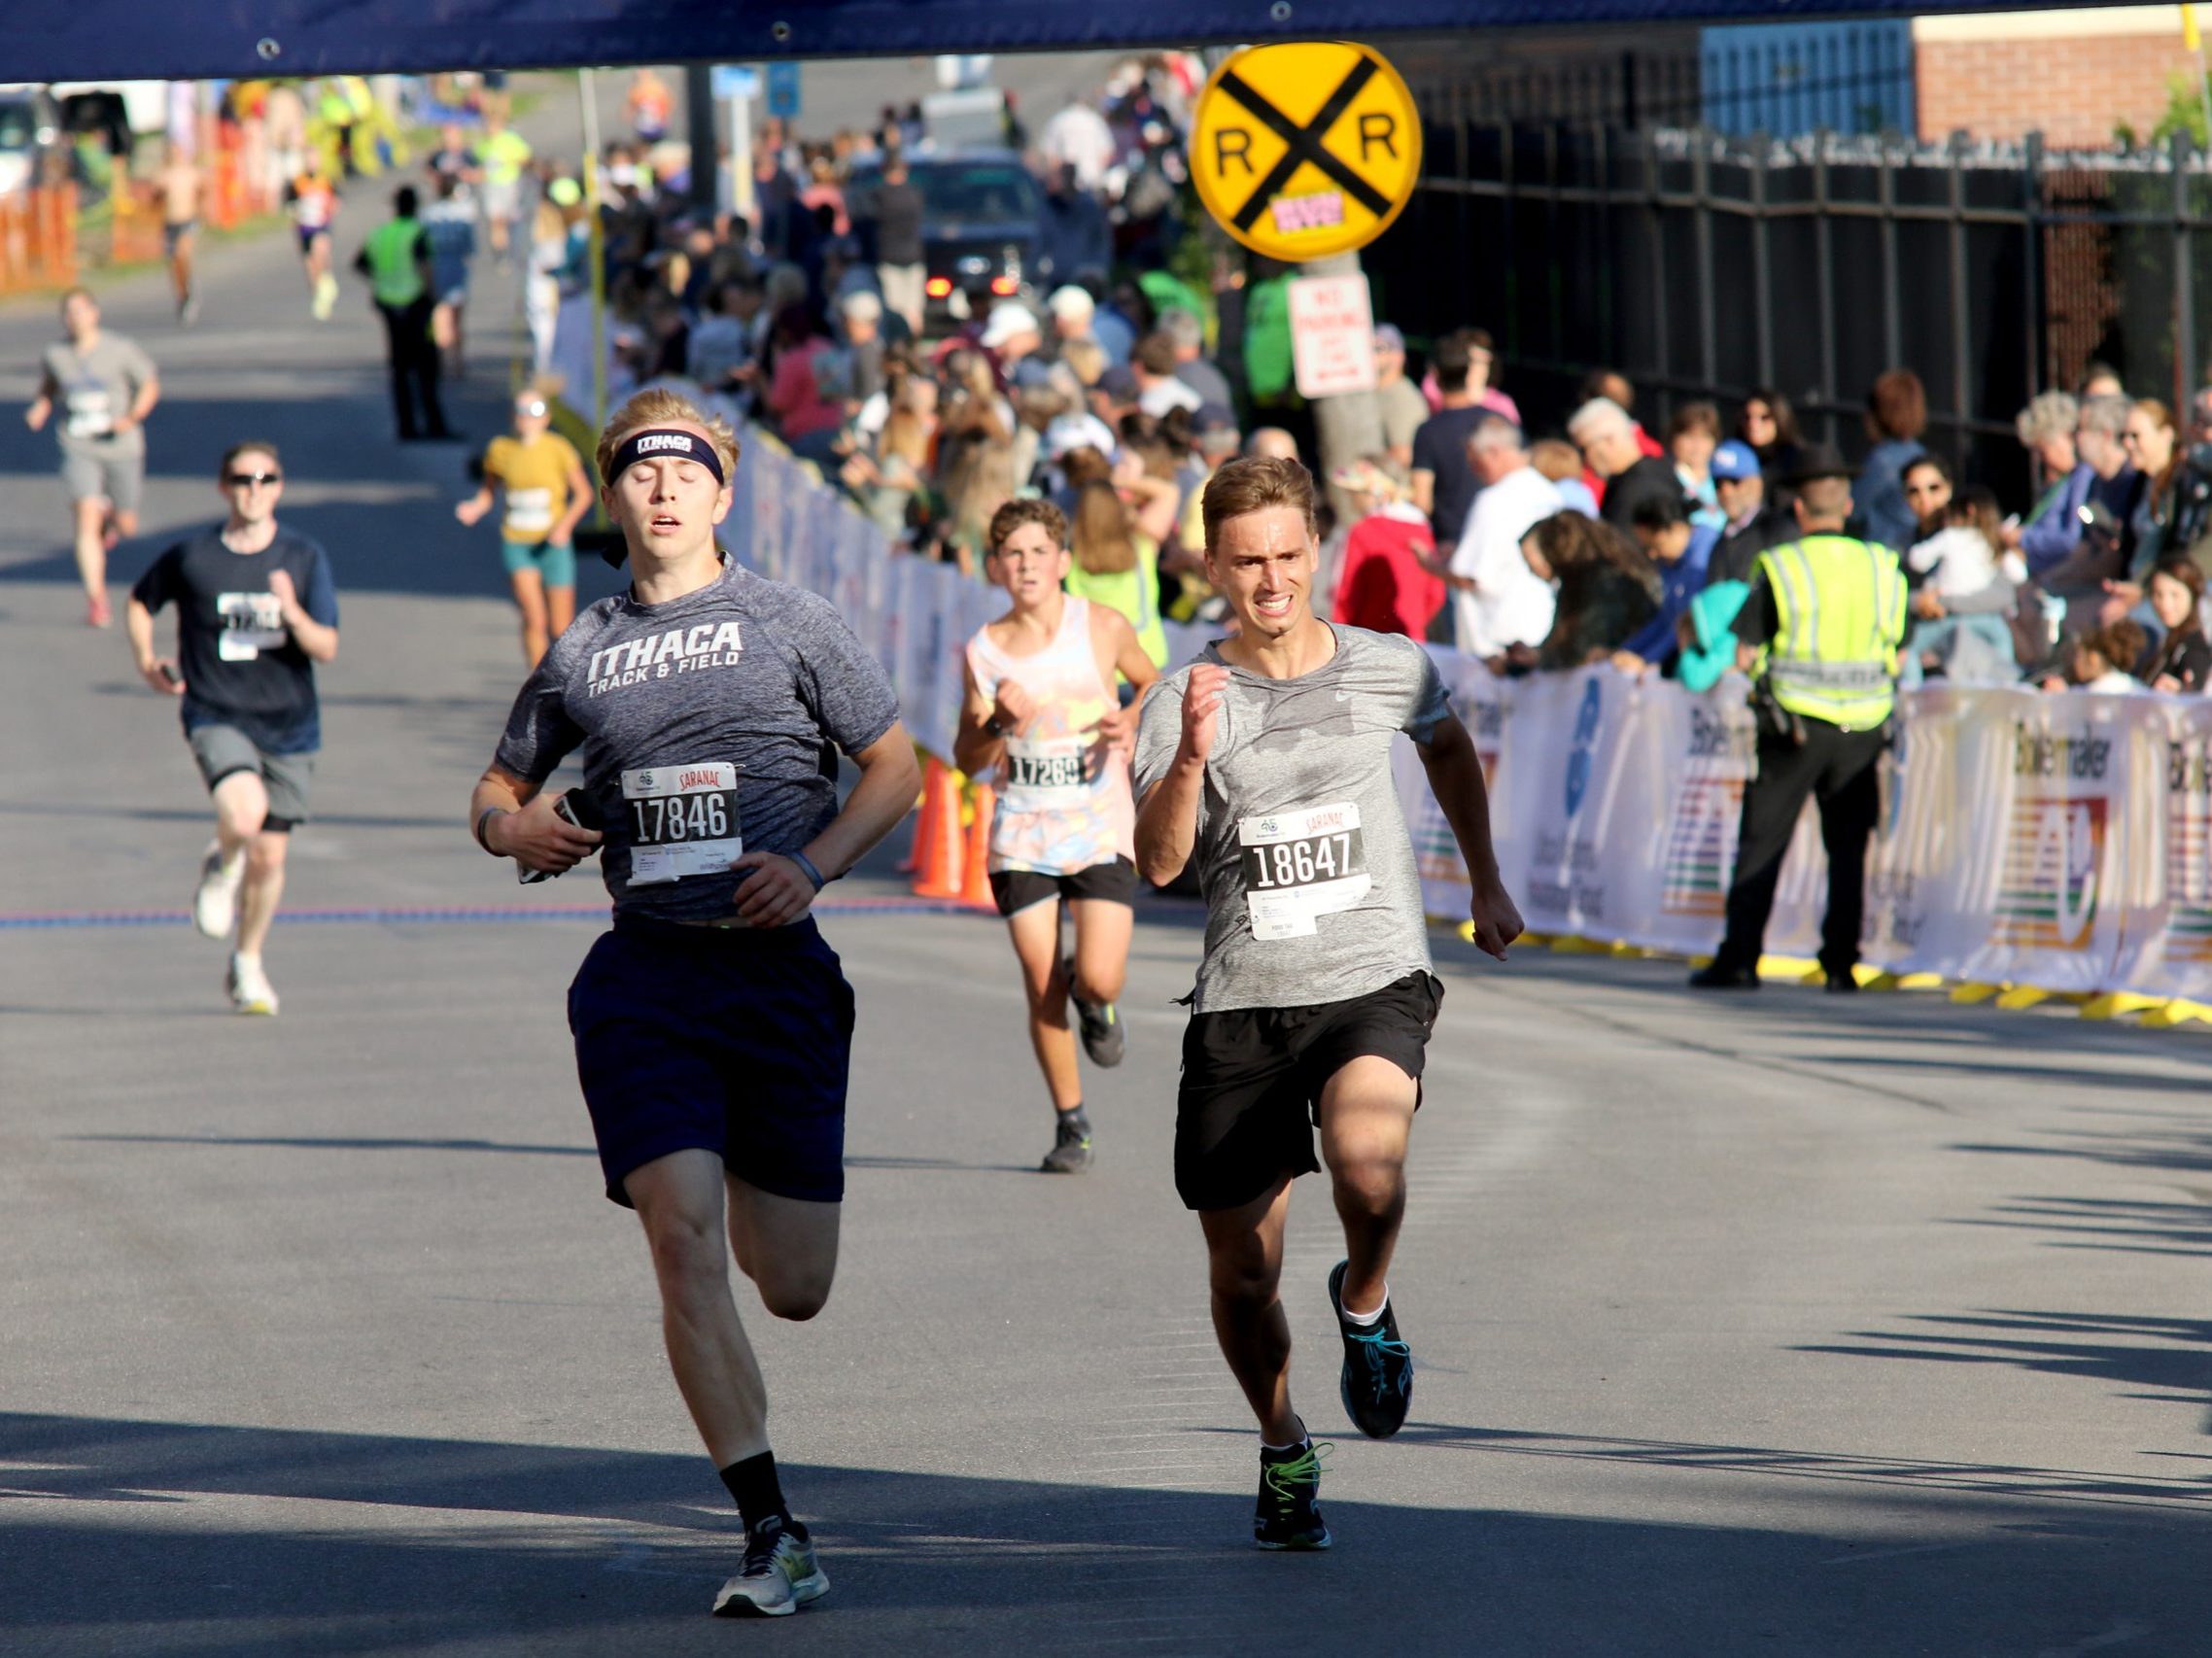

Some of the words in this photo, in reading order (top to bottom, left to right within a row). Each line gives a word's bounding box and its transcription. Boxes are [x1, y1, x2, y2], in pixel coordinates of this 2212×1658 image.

[1215, 127, 1254, 177] R
[1357, 113, 1399, 161] R
[638, 435, 692, 450] ITHACA
[587, 622, 743, 683] ITHACA
[588, 667, 648, 698] TRACK
[657, 663, 671, 677] &
[677, 651, 740, 674] FIELD
[679, 770, 721, 791] SARANAC
[633, 793, 728, 843] 17846
[1253, 833, 1350, 887] 18647
